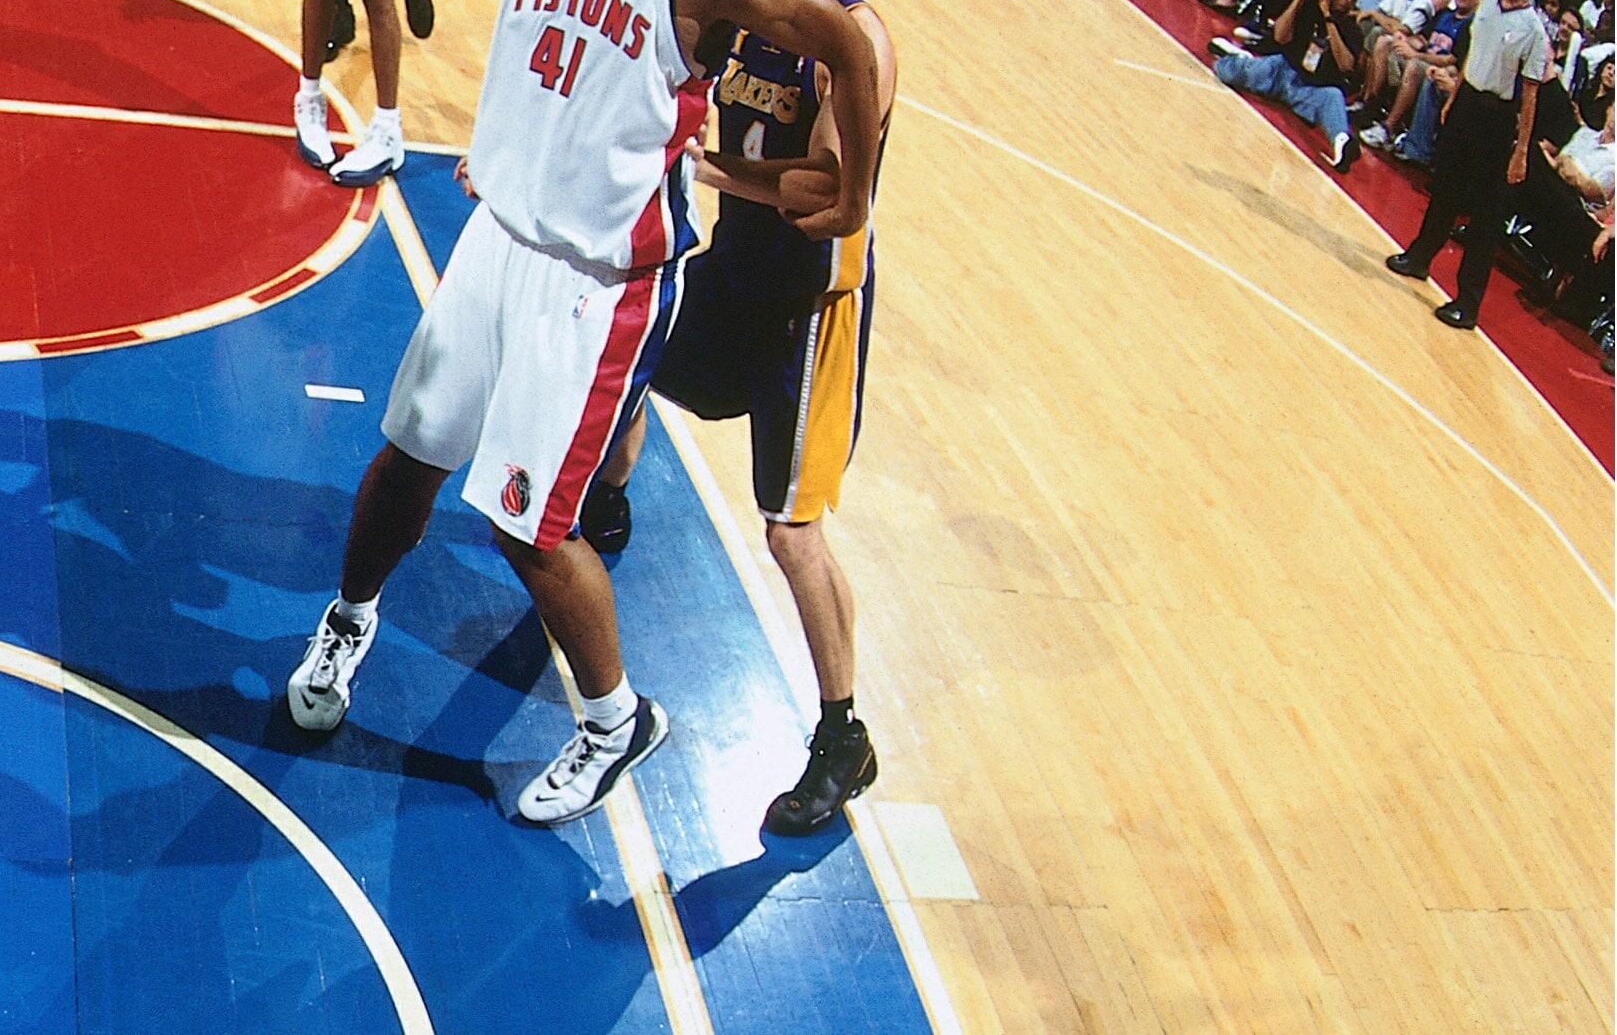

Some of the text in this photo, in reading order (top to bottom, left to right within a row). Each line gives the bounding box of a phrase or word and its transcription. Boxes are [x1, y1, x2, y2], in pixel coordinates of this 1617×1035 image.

[529, 25, 588, 98] 41
[719, 57, 802, 125] LAKERS
[742, 120, 766, 162] 4
